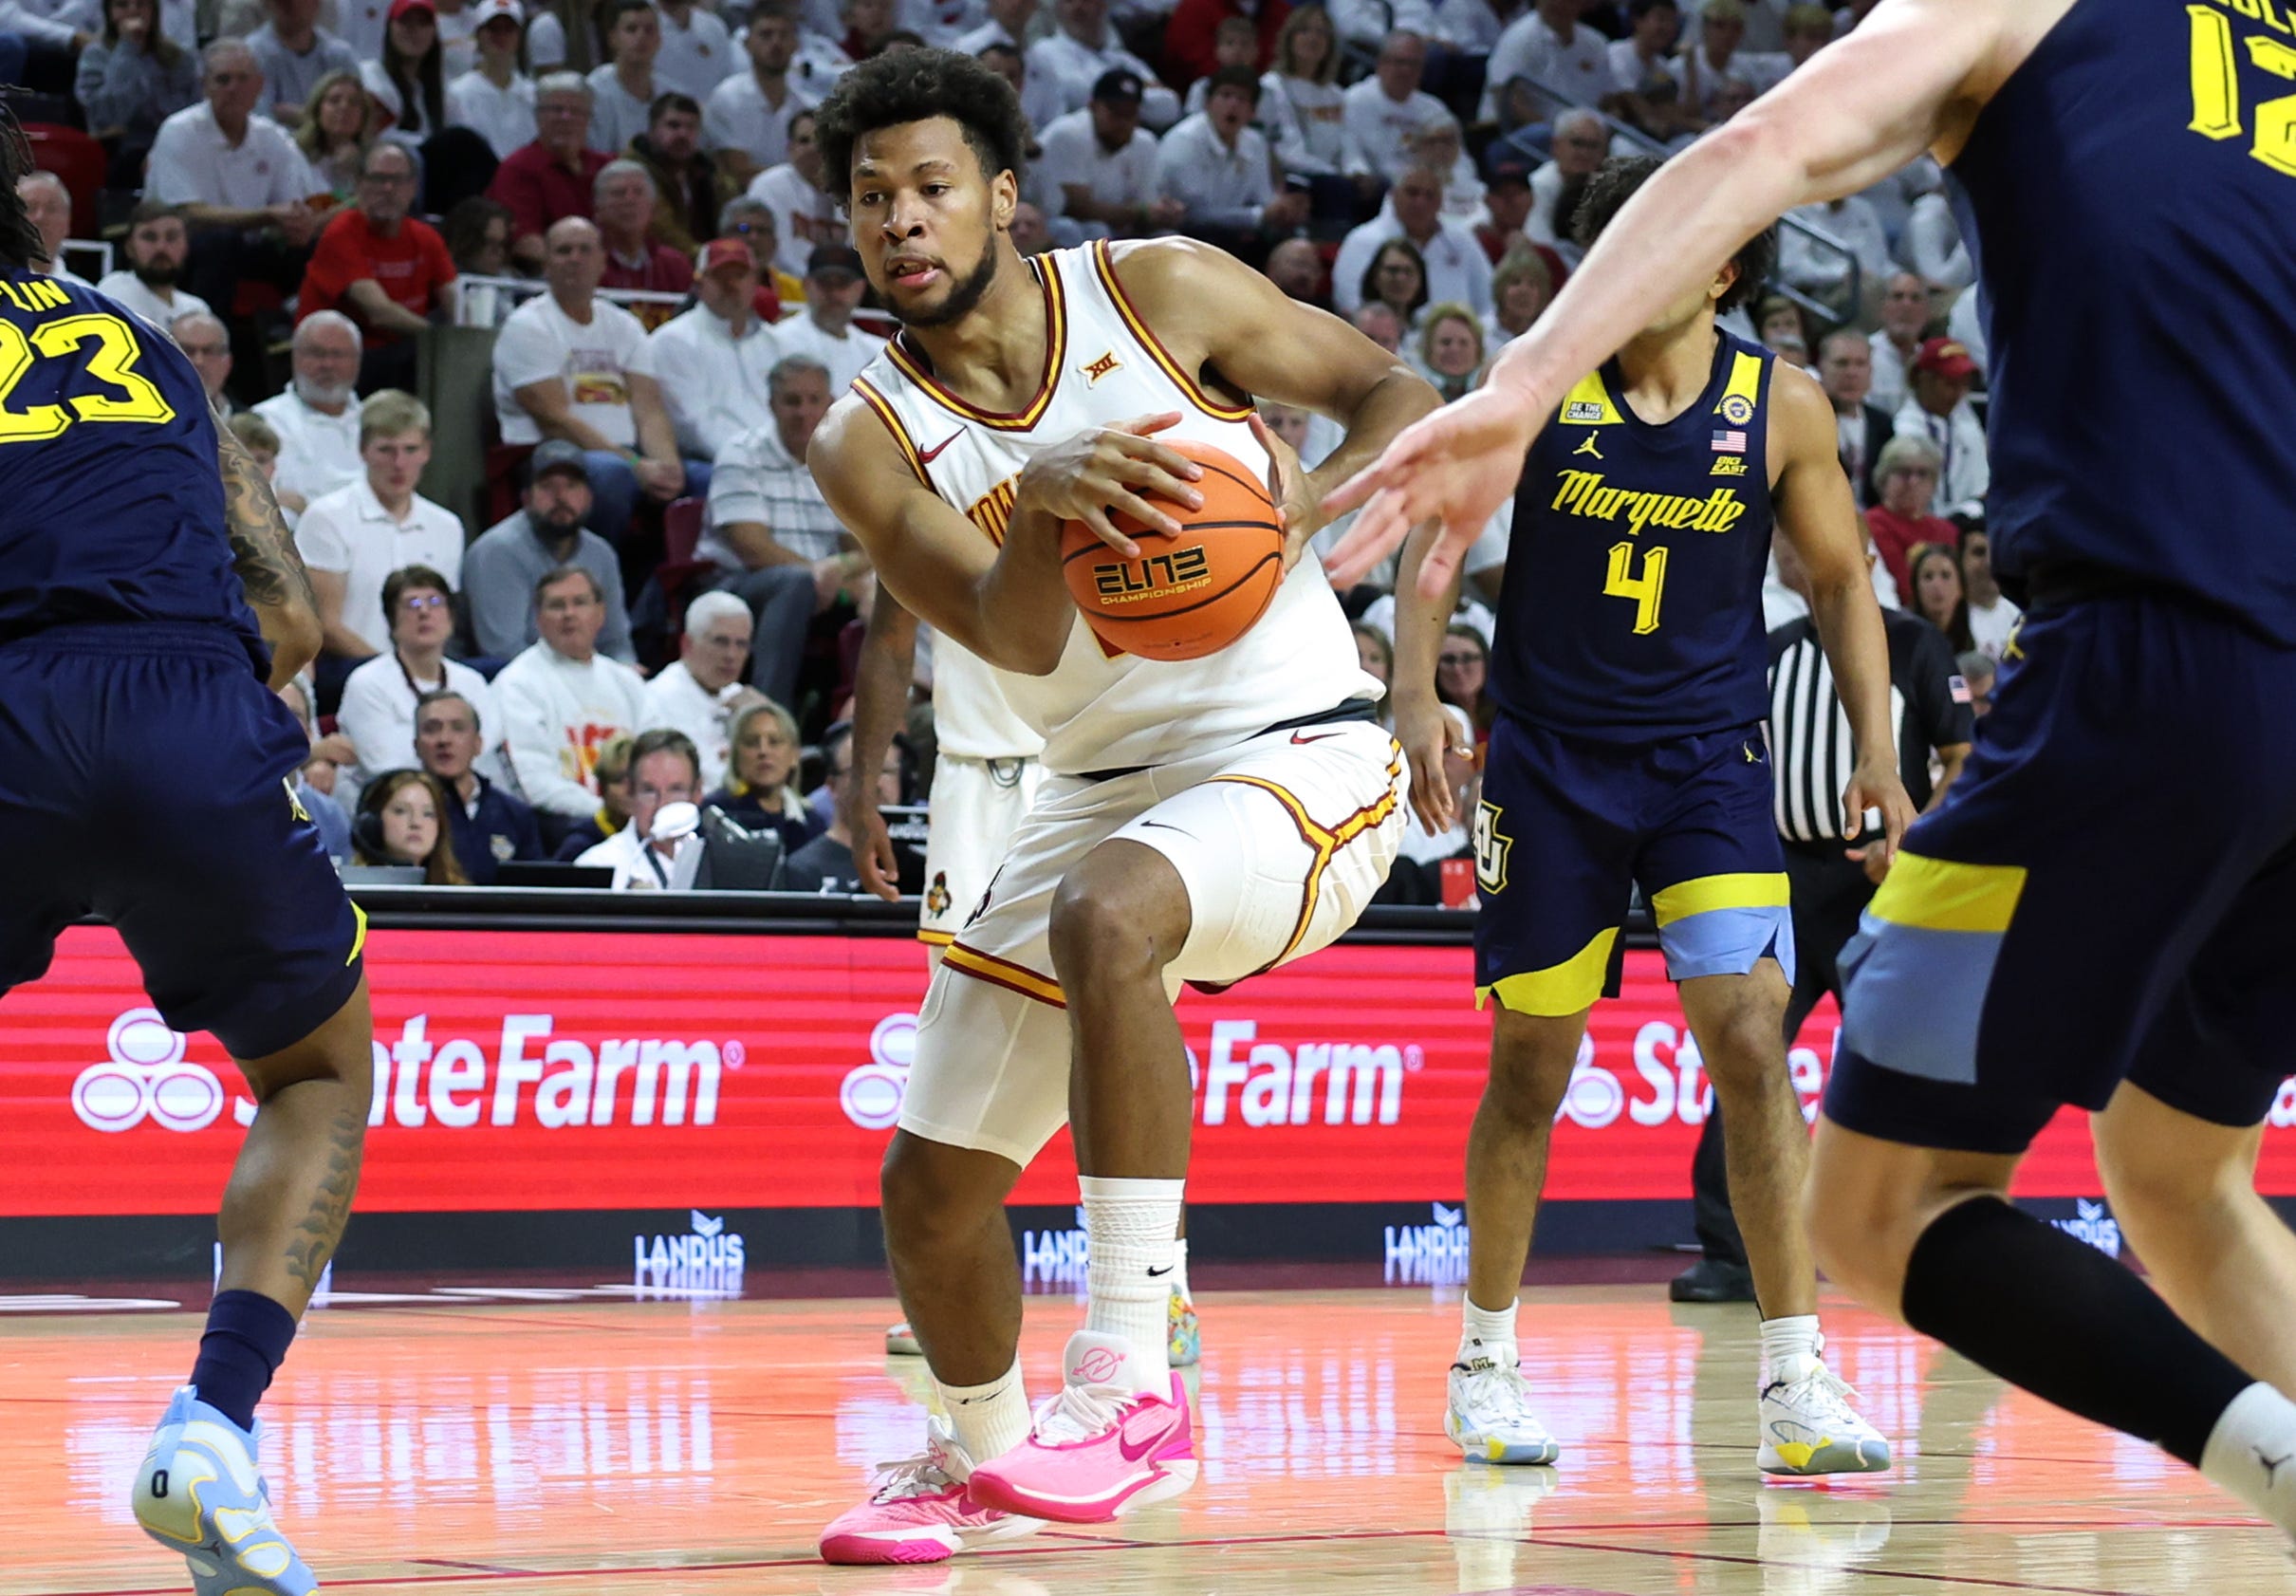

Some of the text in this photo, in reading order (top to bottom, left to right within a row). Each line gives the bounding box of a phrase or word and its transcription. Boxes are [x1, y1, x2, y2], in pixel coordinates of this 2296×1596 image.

[0, 279, 71, 311] LIN
[1566, 411, 1602, 420] CHANGE
[1570, 402, 1602, 412] BE THE
[1711, 464, 1749, 473] EAST
[1715, 456, 1742, 465] BIG
[1551, 469, 1747, 536] Marquette
[1094, 545, 1211, 596] ELITE
[1101, 578, 1213, 605] CHAMPIONSHIP
[1602, 542, 1668, 635] 4
[635, 1234, 745, 1266] LANDUS
[1024, 1230, 1089, 1264] LAND
